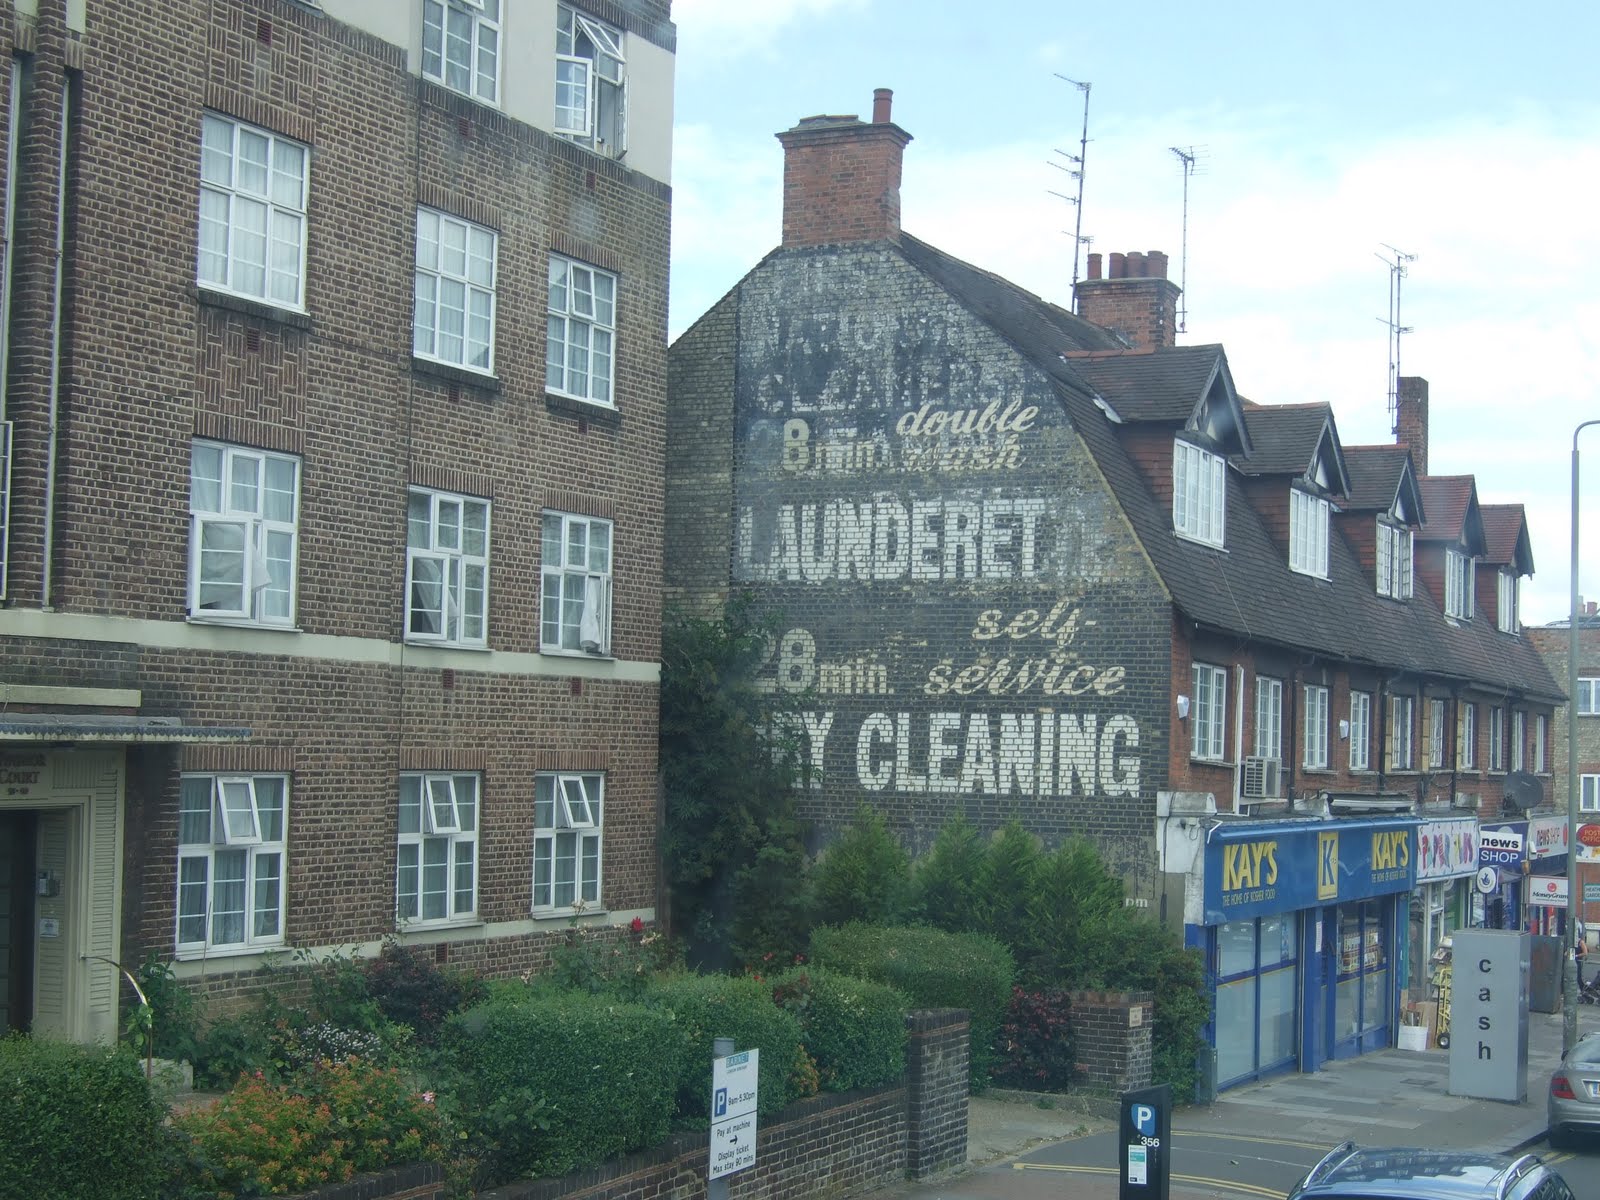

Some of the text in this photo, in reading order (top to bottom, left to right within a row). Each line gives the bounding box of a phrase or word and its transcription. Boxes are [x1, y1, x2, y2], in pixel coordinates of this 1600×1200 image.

[896, 398, 1039, 437] double
[971, 599, 1098, 649] self-
[924, 657, 1126, 696] service
[856, 712, 1141, 798] CLEANING
[1371, 831, 1409, 871] KAY'S
[1480, 850, 1519, 863] SHOP
[1481, 837, 1520, 849] news
[1222, 841, 1278, 890] KAY'S
[1322, 840, 1336, 887] K
[1478, 958, 1492, 1060] cash
[717, 1091, 725, 1114] P
[1138, 1107, 1151, 1129] P
[716, 1120, 751, 1138] Pay at machine
[1140, 1136, 1160, 1147] 356
[712, 1154, 754, 1174] Max stay 90 mins
[718, 1144, 750, 1162] Display ticket
